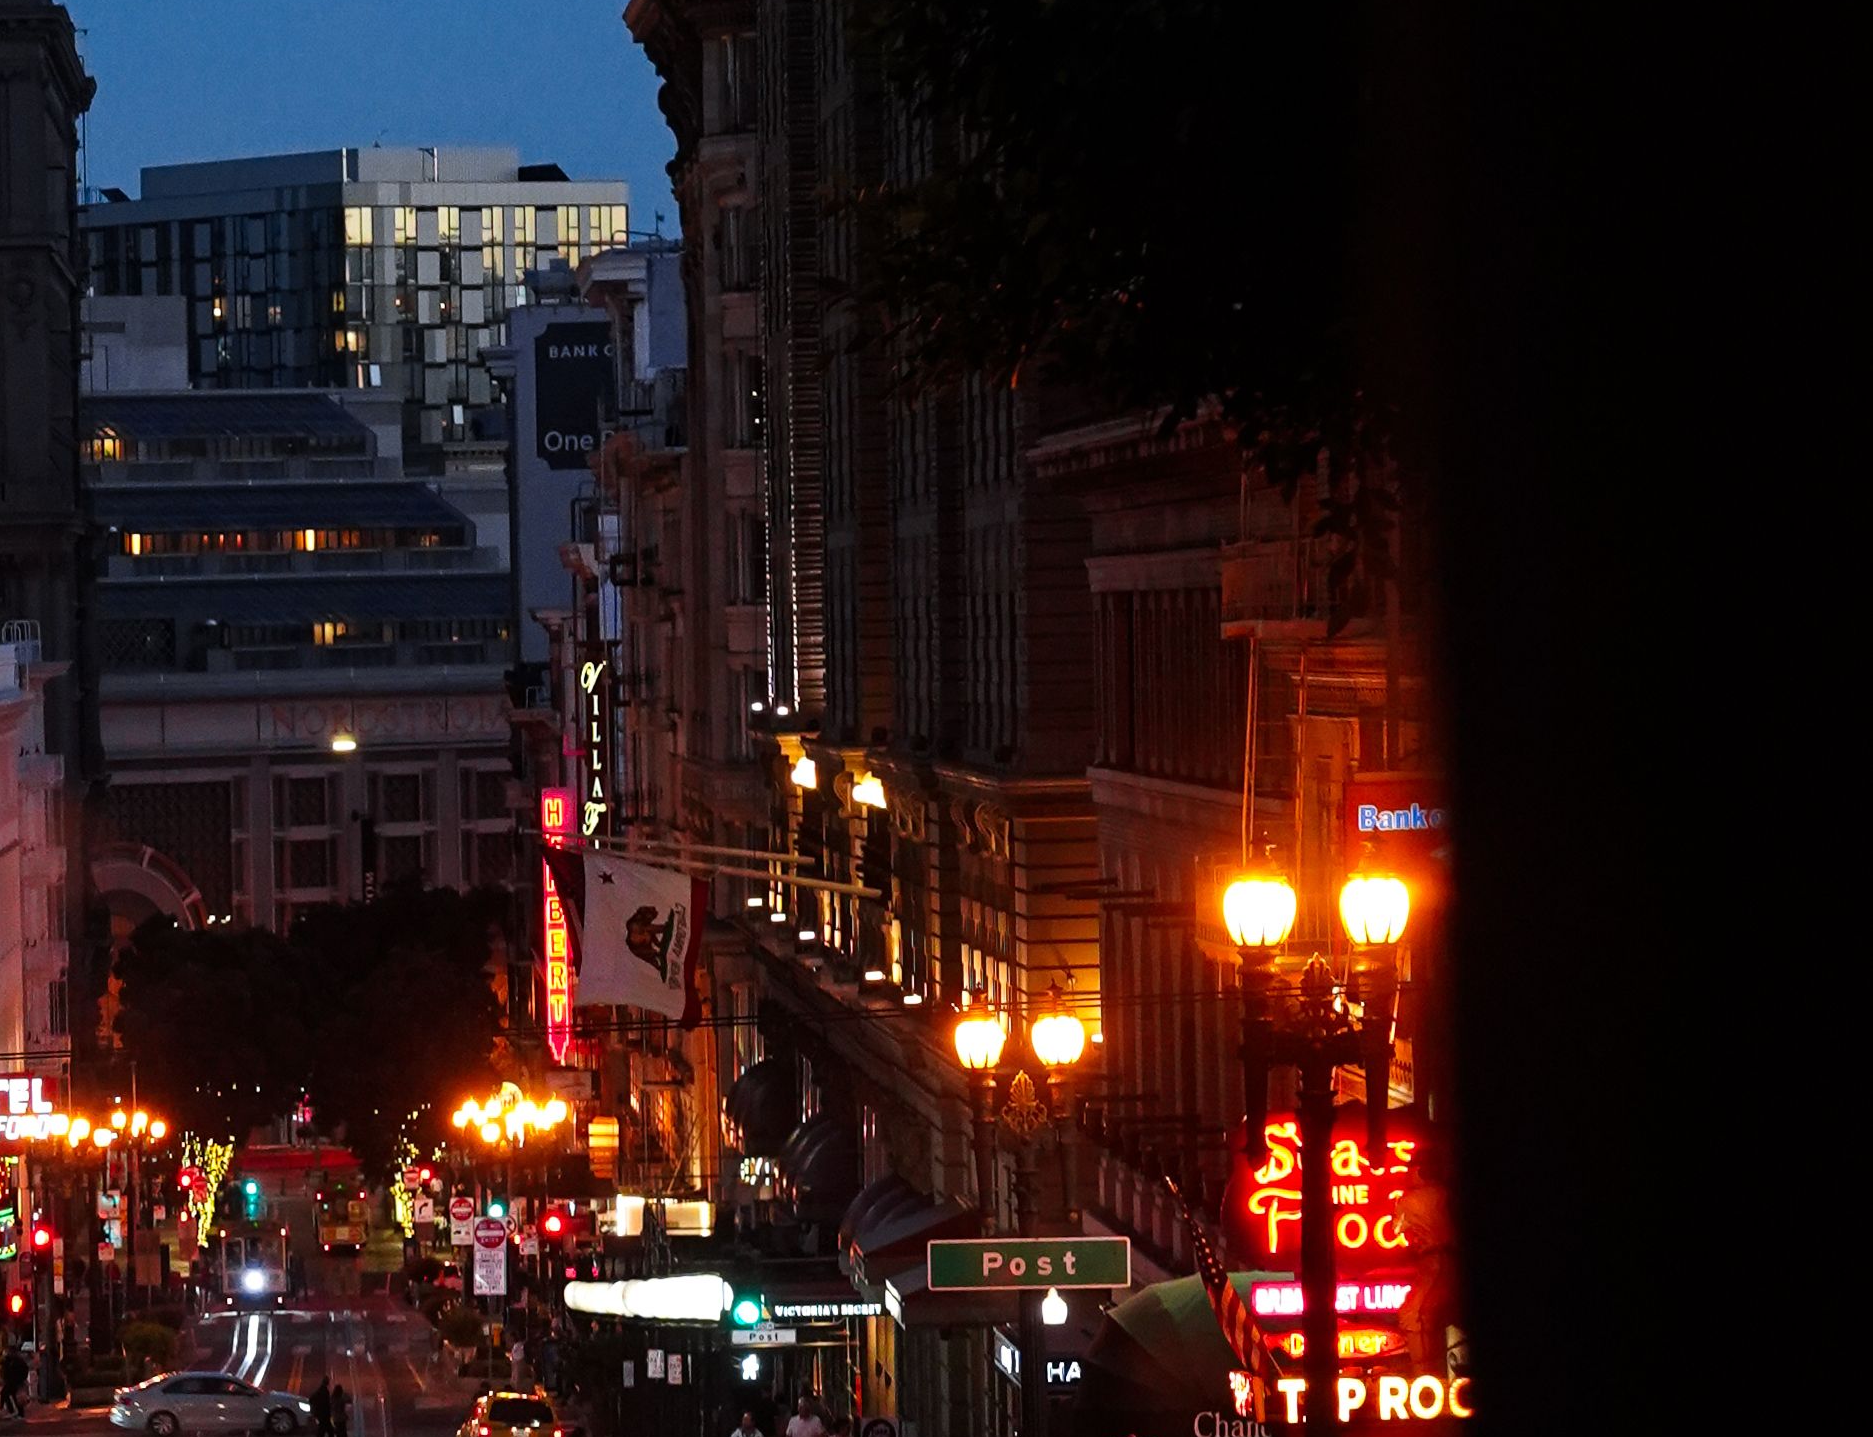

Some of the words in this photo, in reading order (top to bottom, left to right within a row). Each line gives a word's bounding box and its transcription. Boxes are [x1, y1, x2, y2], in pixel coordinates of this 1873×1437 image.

[544, 430, 594, 453] One
[1359, 803, 1428, 831] Bank
[1331, 1185, 1369, 1205] INE
[982, 1250, 1077, 1277] Post
[748, 1332, 779, 1341] Post
[1276, 1377, 1368, 1424] TP
